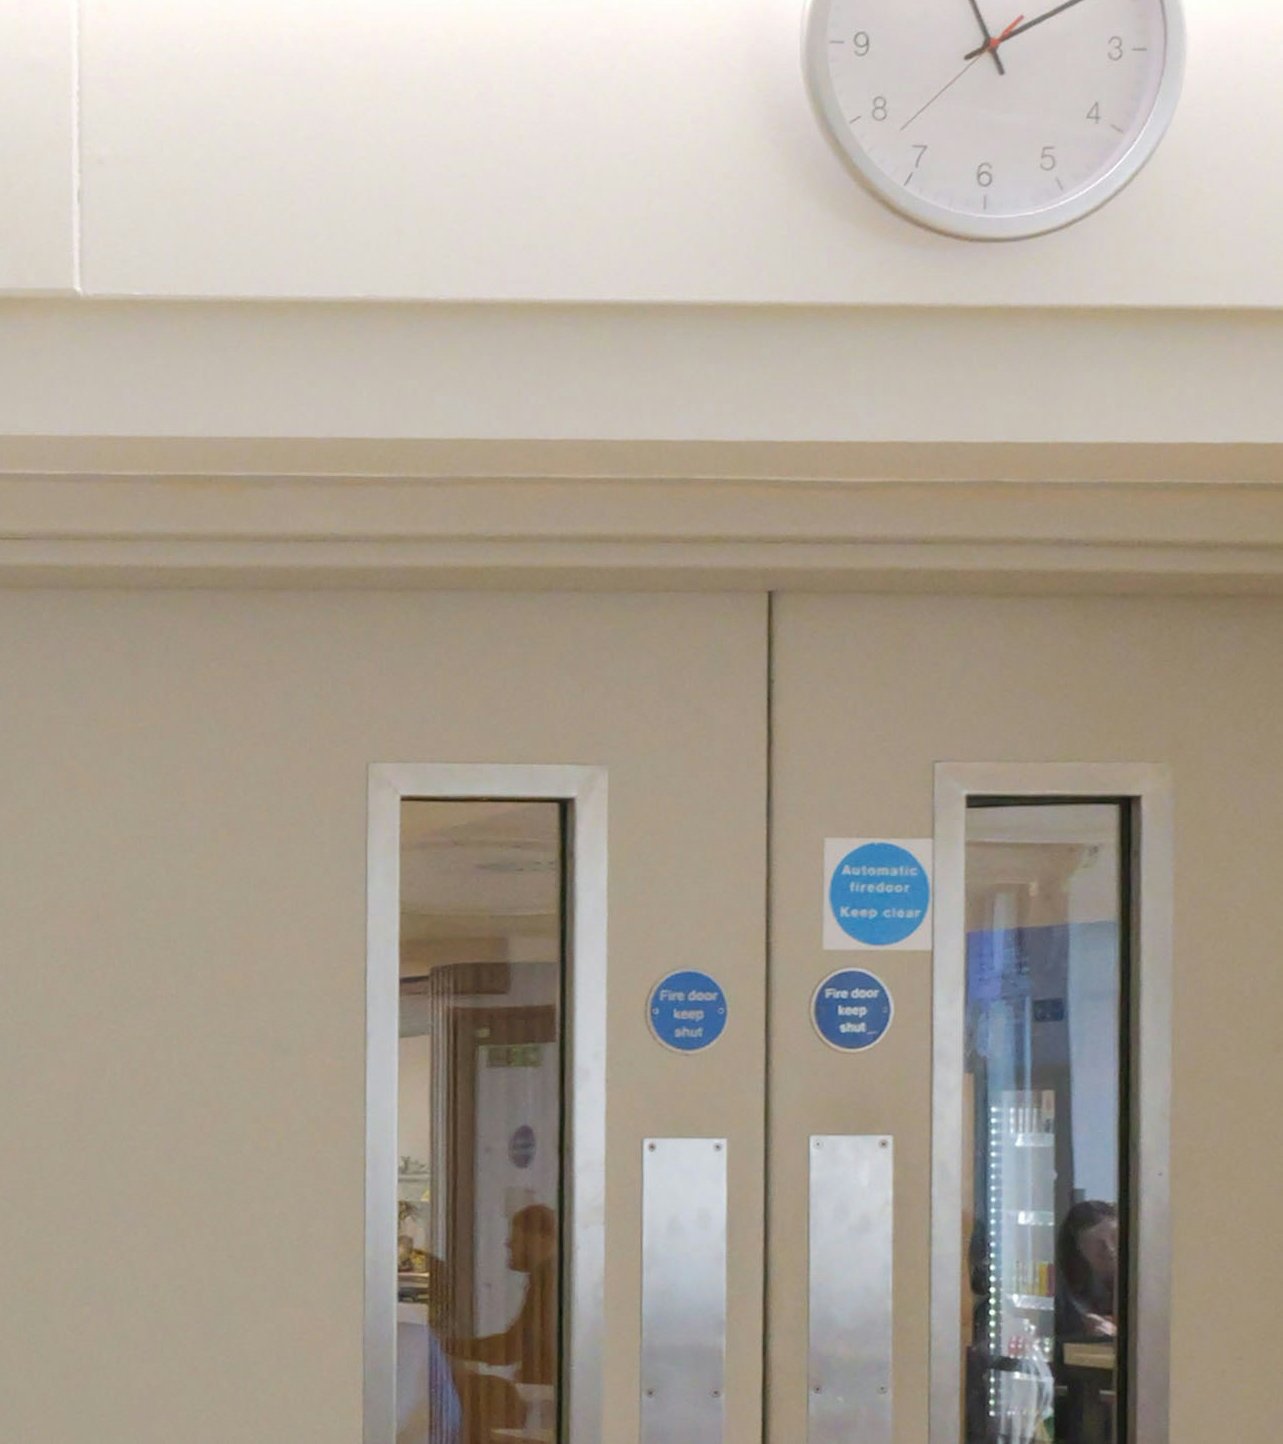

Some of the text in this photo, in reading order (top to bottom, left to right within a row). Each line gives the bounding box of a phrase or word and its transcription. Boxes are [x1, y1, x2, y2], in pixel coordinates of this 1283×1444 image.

[852, 31, 871, 58] 9
[1107, 35, 1124, 61] 3
[871, 95, 888, 122] 8
[1085, 101, 1102, 125] 4
[911, 144, 929, 169] 7
[1039, 145, 1057, 172] 5
[976, 162, 993, 188] 6
[841, 864, 918, 877] Automatic
[849, 882, 910, 894] firedoor
[839, 906, 922, 920] Keep clear
[659, 989, 718, 1001] Fire door
[825, 987, 880, 999] Fire door
[673, 1008, 705, 1022] keep
[837, 1004, 868, 1018] keep
[674, 1026, 703, 1038] shut
[839, 1022, 866, 1033] shut
